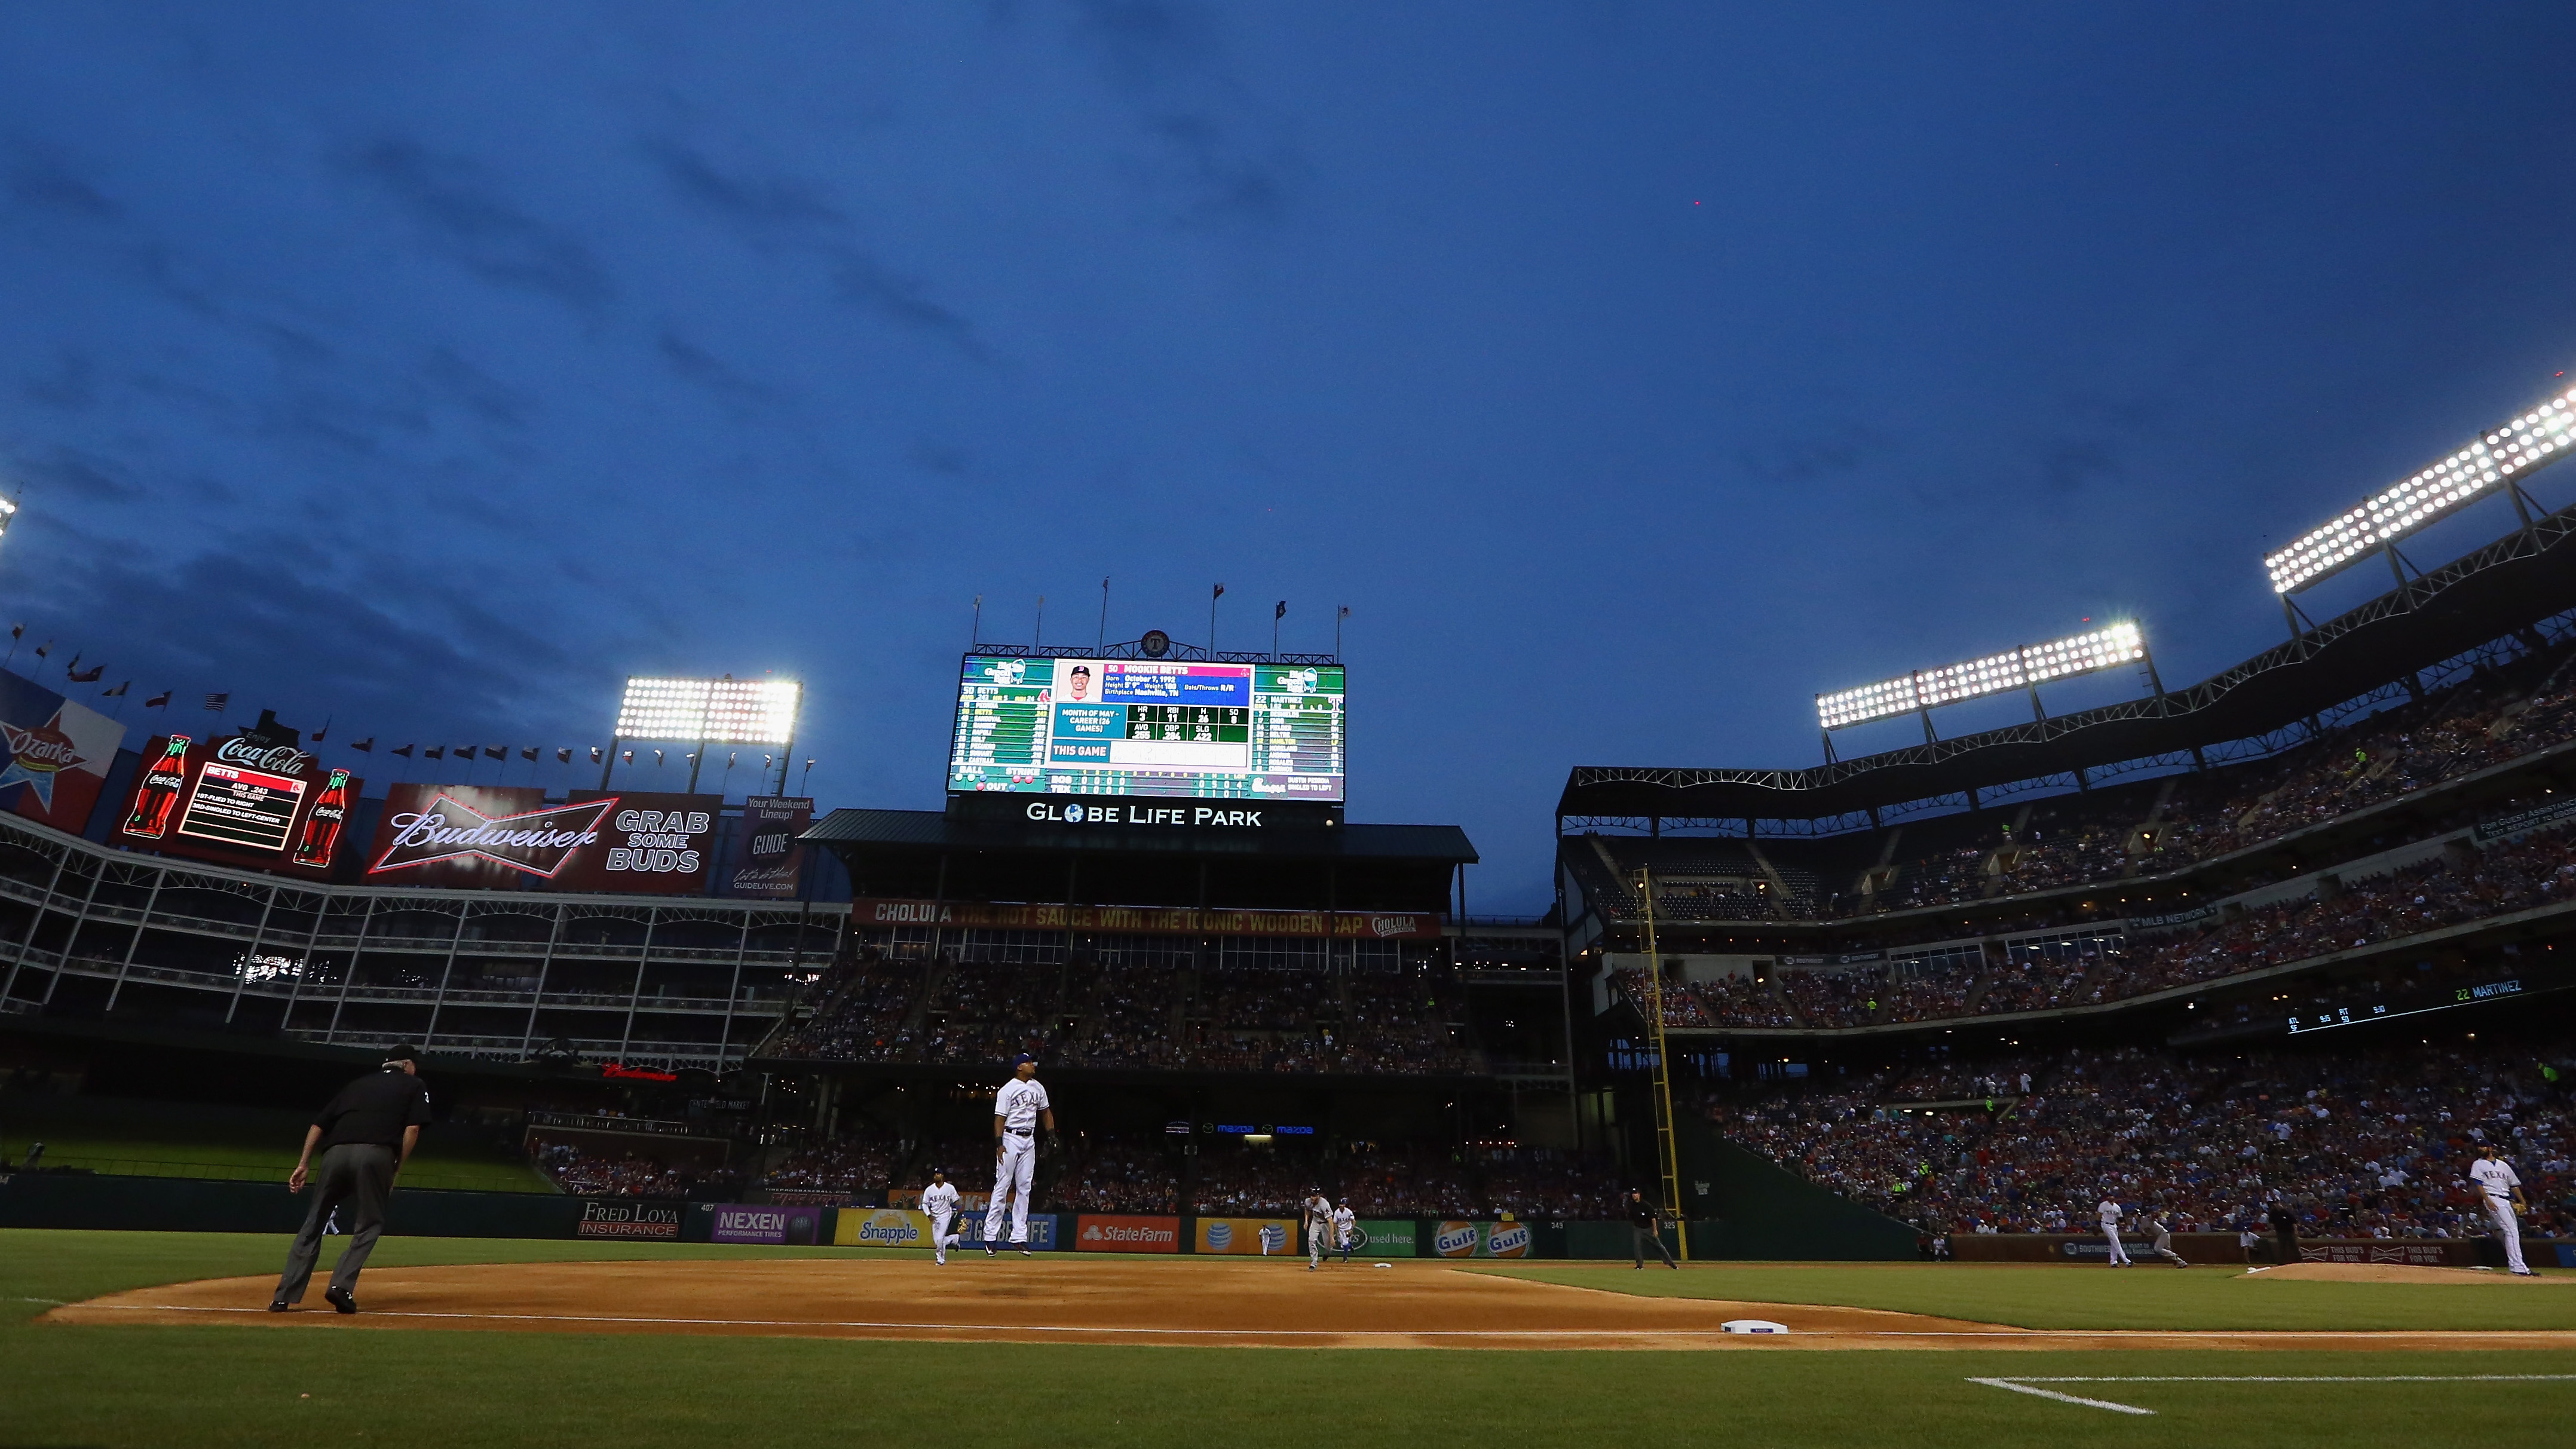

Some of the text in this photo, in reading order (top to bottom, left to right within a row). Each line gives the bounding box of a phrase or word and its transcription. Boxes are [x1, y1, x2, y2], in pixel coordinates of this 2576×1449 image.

[1124, 665, 1158, 673] MOOKIE
[1160, 666, 1189, 675] BETTS
[1135, 688, 1168, 697] Nashville,
[1168, 714, 1178, 722] 11
[1197, 715, 1209, 723] 26
[1230, 716, 1238, 724] 8
[246, 731, 271, 743] Enjoy
[1132, 731, 1212, 742] .255 .284 .422
[10, 731, 76, 764] Ozarka
[1053, 745, 1076, 755] THIS
[1078, 746, 1107, 756] GAME
[217, 737, 311, 776] Coca-Cola
[206, 765, 239, 779] BETTS
[1006, 767, 1040, 776] STRIKE
[231, 782, 269, 795] AVG .243
[987, 782, 1007, 791] OUT
[1050, 785, 1071, 793] TEX
[197, 793, 226, 802] 1ST-FLIED
[247, 794, 265, 802] GAME
[749, 798, 810, 809] Your Weekend
[192, 802, 232, 814] 3RD-SINGLED
[241, 811, 280, 824] LEFT-CENTER
[760, 809, 794, 821] Lineup!
[1129, 805, 1185, 825] LIFE
[1194, 807, 1262, 827] PARK
[2481, 798, 2576, 831] FOR GUEST ASSISTANC
[614, 810, 710, 834] GRAB
[390, 811, 598, 848] Budweiser
[627, 833, 690, 849] SOME
[753, 833, 789, 854] GUIDE
[606, 848, 700, 873] BUDS
[734, 882, 794, 890] GUIDELIVE.COM
[1099, 909, 1142, 928] WITH
[1148, 911, 1181, 930] THE
[1249, 914, 1323, 933] WOODEN
[2142, 907, 2207, 927] MLB NETWORK
[1372, 917, 1415, 936] CHOLULA
[2455, 980, 2522, 1001] 22 MARTINEZ
[2339, 1007, 2348, 1016] PIT
[728, 1100, 750, 1110] MARKET
[1217, 1125, 1255, 1134] mazda
[1276, 1126, 1314, 1135] mazda
[582, 1202, 678, 1224] FRED LOYA
[701, 1203, 714, 1212] 407
[719, 1212, 785, 1230] NEXEN
[580, 1224, 676, 1236] INSURANCE
[859, 1220, 918, 1245] Snapple
[1370, 1233, 1390, 1243] used
[1392, 1233, 1414, 1243] here.
[1438, 1230, 1475, 1250] Gulf
[1490, 1230, 1526, 1251] Gulf
